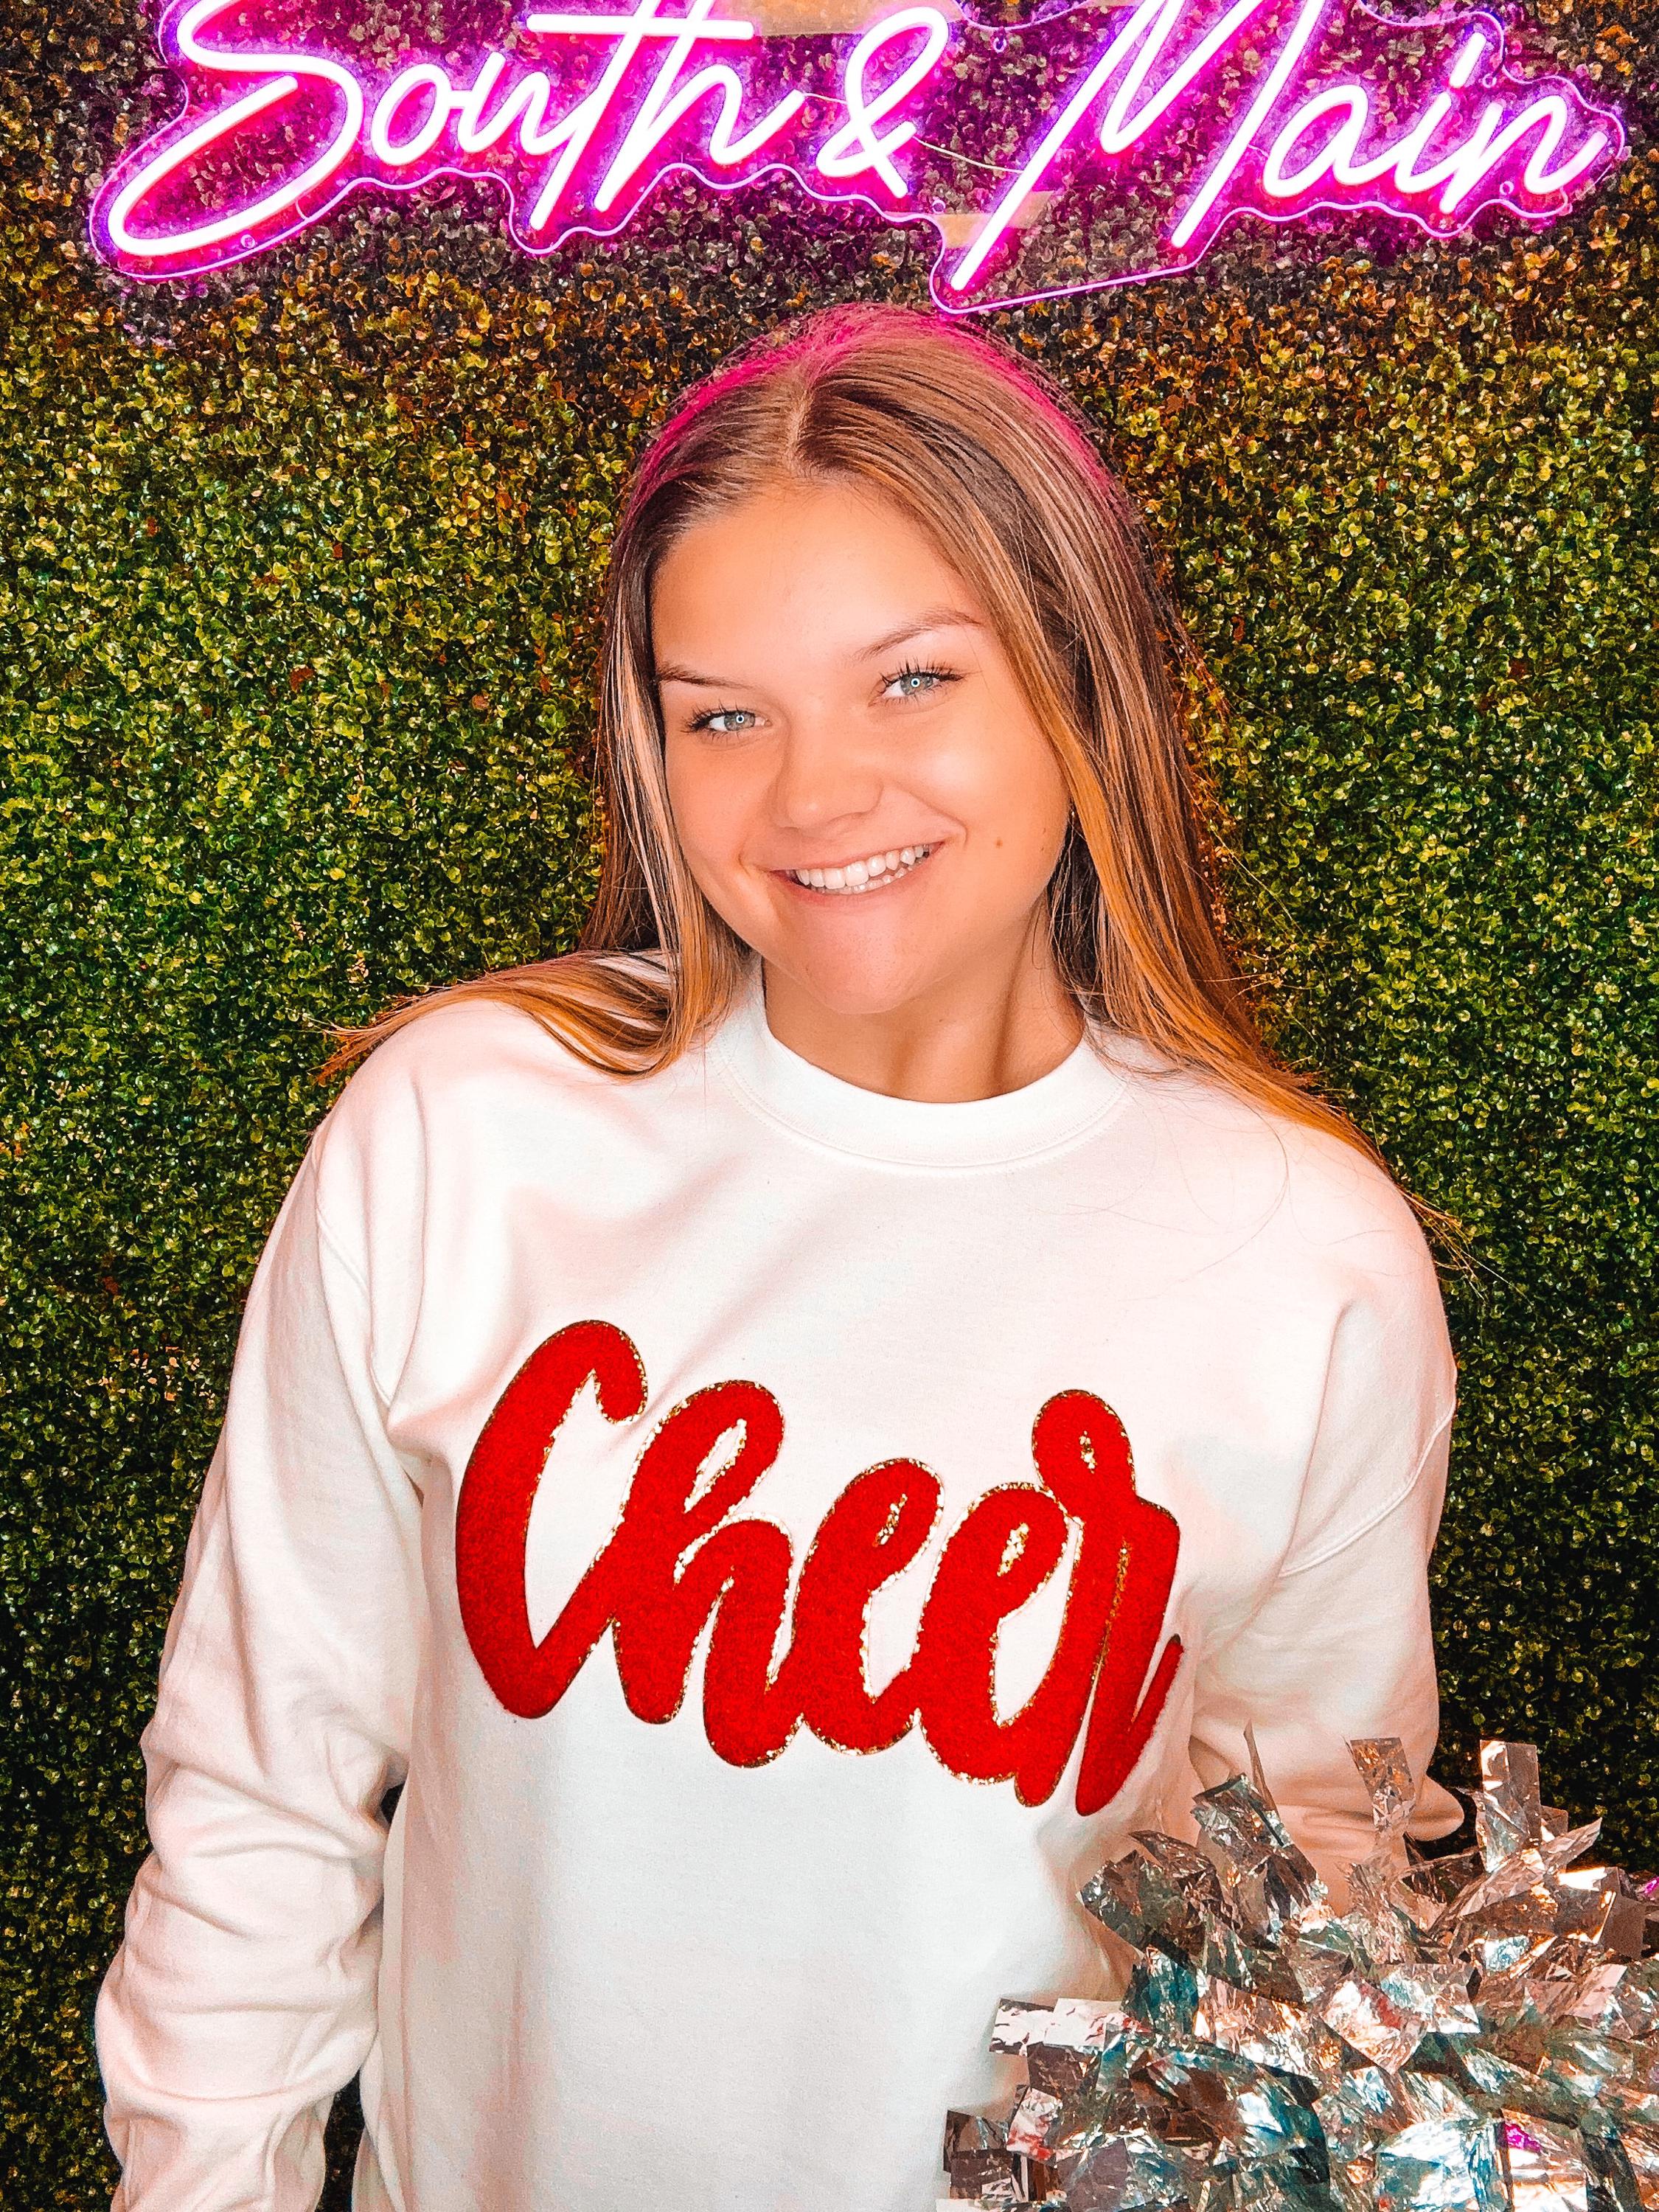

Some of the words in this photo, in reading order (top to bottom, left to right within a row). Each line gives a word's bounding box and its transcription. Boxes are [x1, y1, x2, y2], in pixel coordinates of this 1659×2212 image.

[107, 0, 804, 254] South
[815, 3, 949, 199] &
[951, 0, 1607, 291] Main
[455, 1319, 1183, 1816] Cheer
